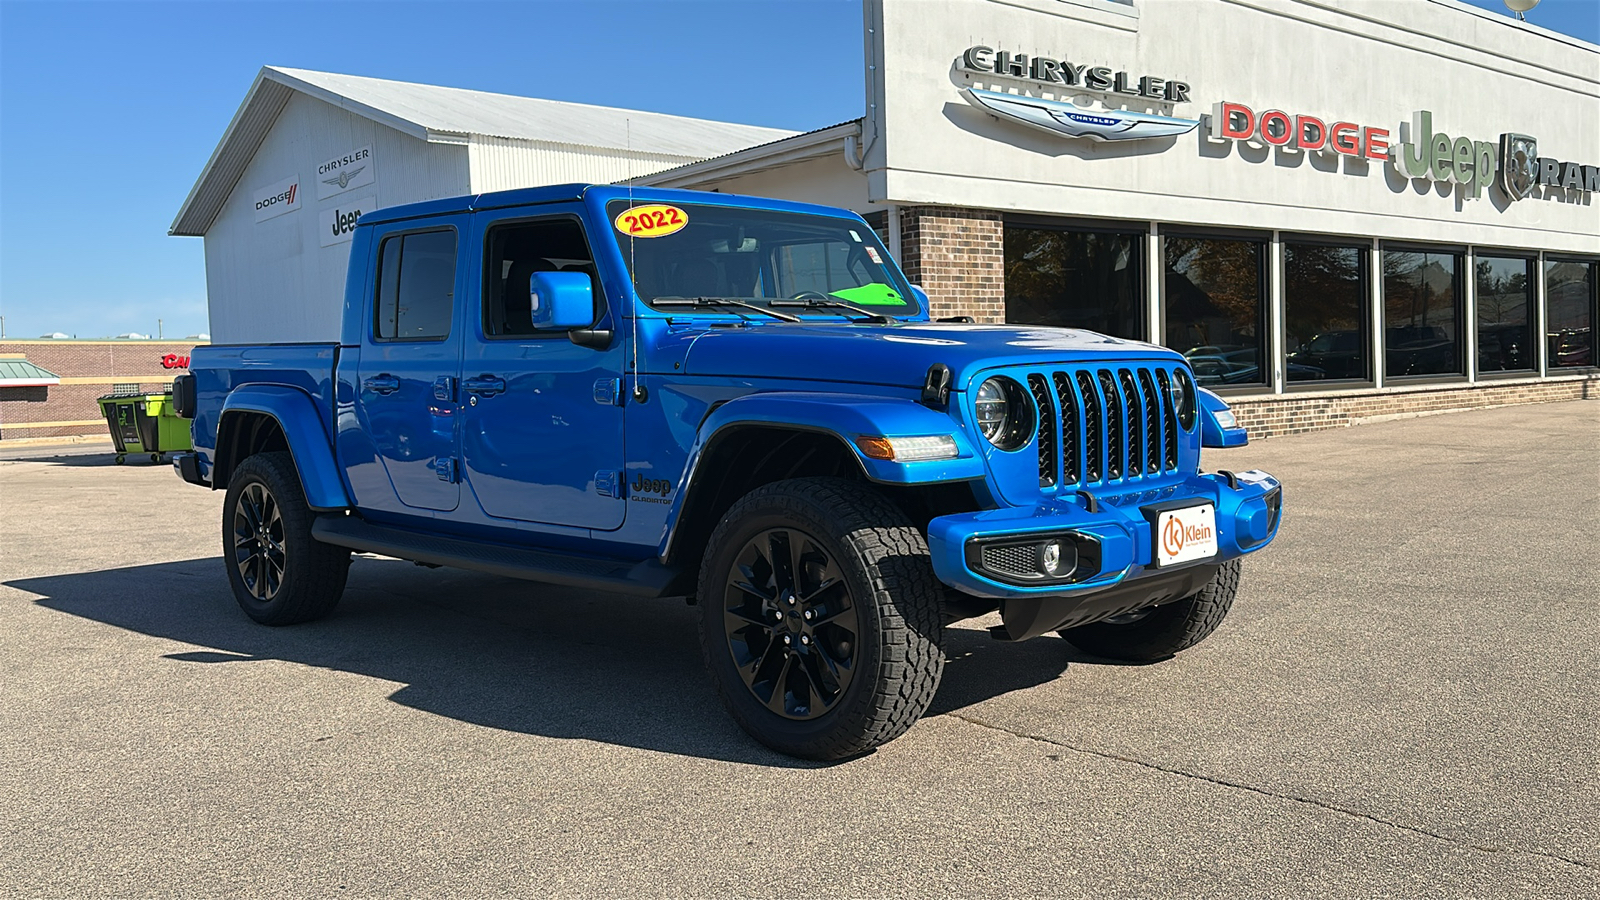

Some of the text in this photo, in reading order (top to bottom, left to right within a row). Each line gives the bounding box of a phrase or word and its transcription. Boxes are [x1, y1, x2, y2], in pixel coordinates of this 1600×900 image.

[964, 45, 1191, 103] CHRYSLER
[1070, 114, 1115, 124] CHRYSLER
[1213, 101, 1390, 161] DODGE
[318, 149, 369, 175] CHRYSLER
[1396, 110, 1496, 200] Jeep
[255, 190, 292, 211] DODGE
[624, 208, 683, 233] 2022
[631, 473, 671, 498] Jeep
[631, 495, 673, 505] GLADIATOR
[1185, 523, 1211, 542] Klein
